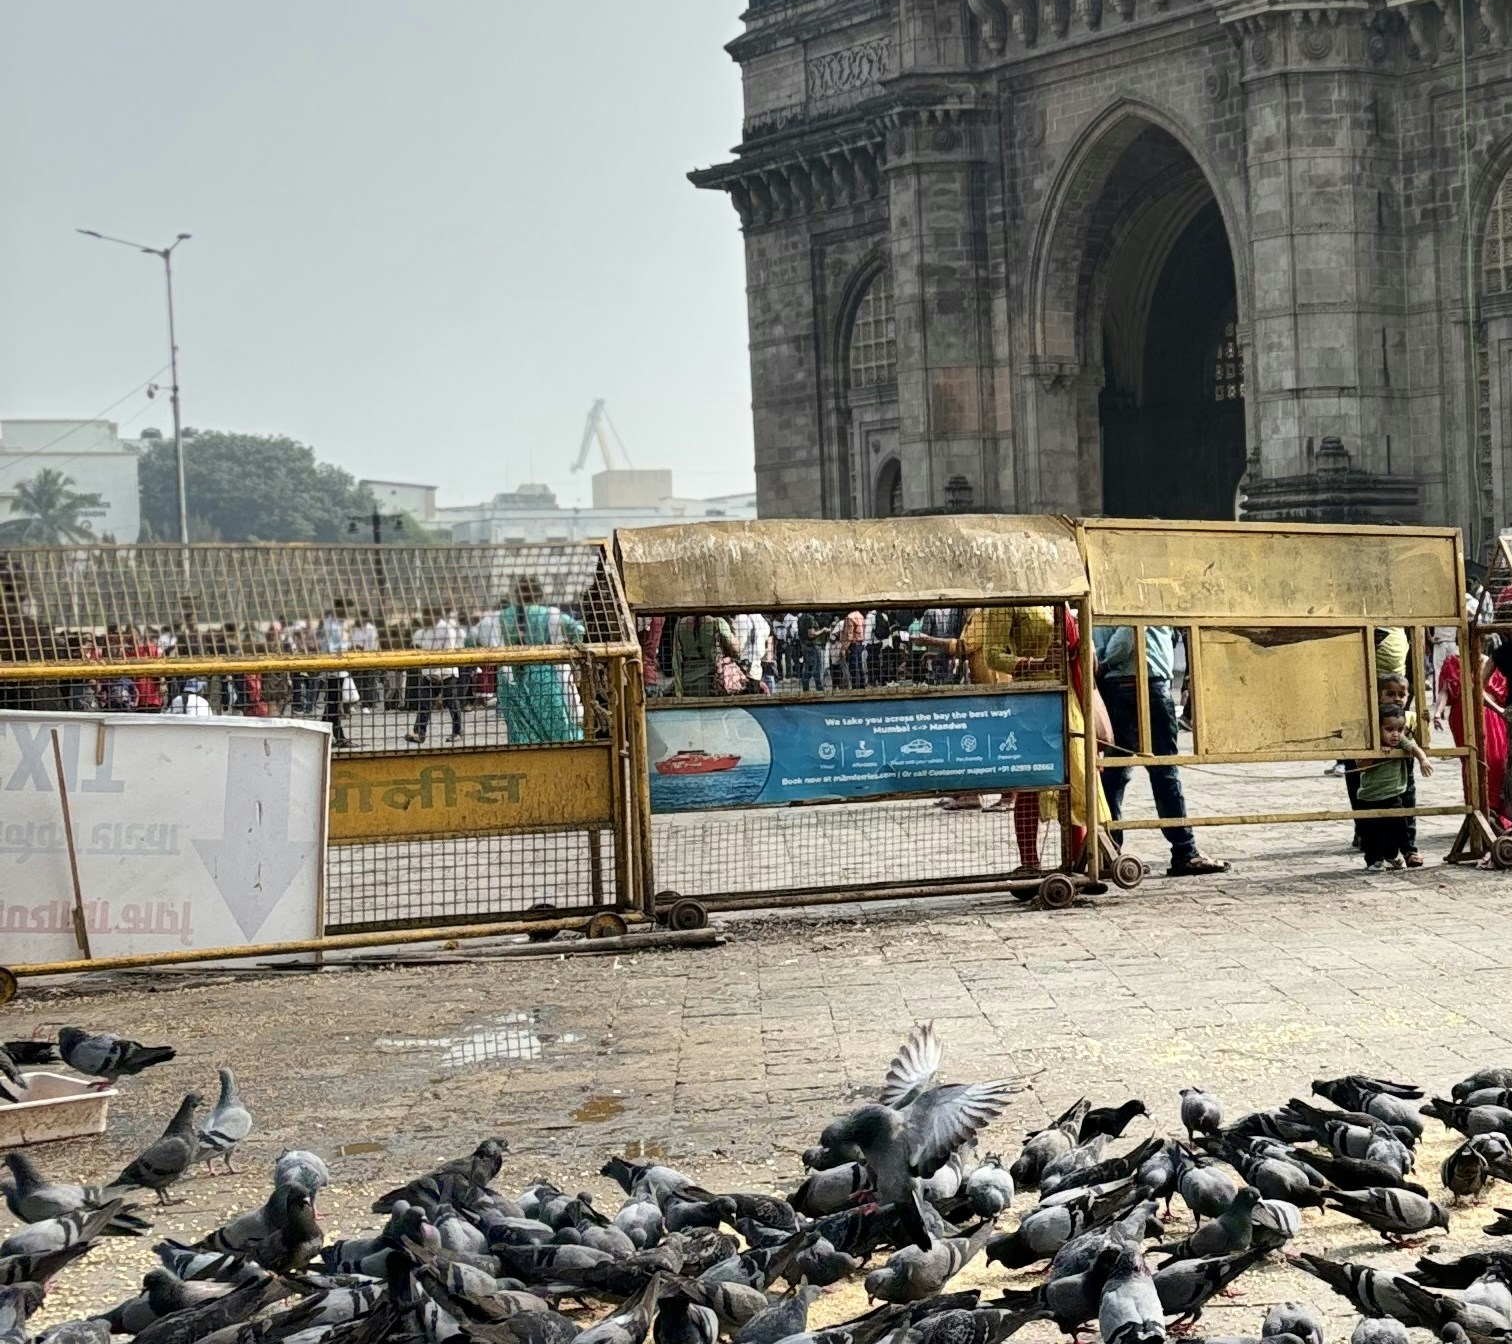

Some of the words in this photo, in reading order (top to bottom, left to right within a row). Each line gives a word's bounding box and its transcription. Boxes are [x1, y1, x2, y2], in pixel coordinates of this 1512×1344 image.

[824, 717, 841, 727] We
[842, 716, 864, 726] take
[864, 716, 883, 727] you
[884, 715, 915, 724] across
[915, 713, 932, 722] the
[932, 712, 950, 722] bay
[951, 710, 968, 720] the
[968, 709, 990, 719] best
[872, 724, 911, 735] Mumbai
[929, 722, 968, 732] Mandwa
[781, 776, 803, 786] Book
[966, 765, 997, 775] support
